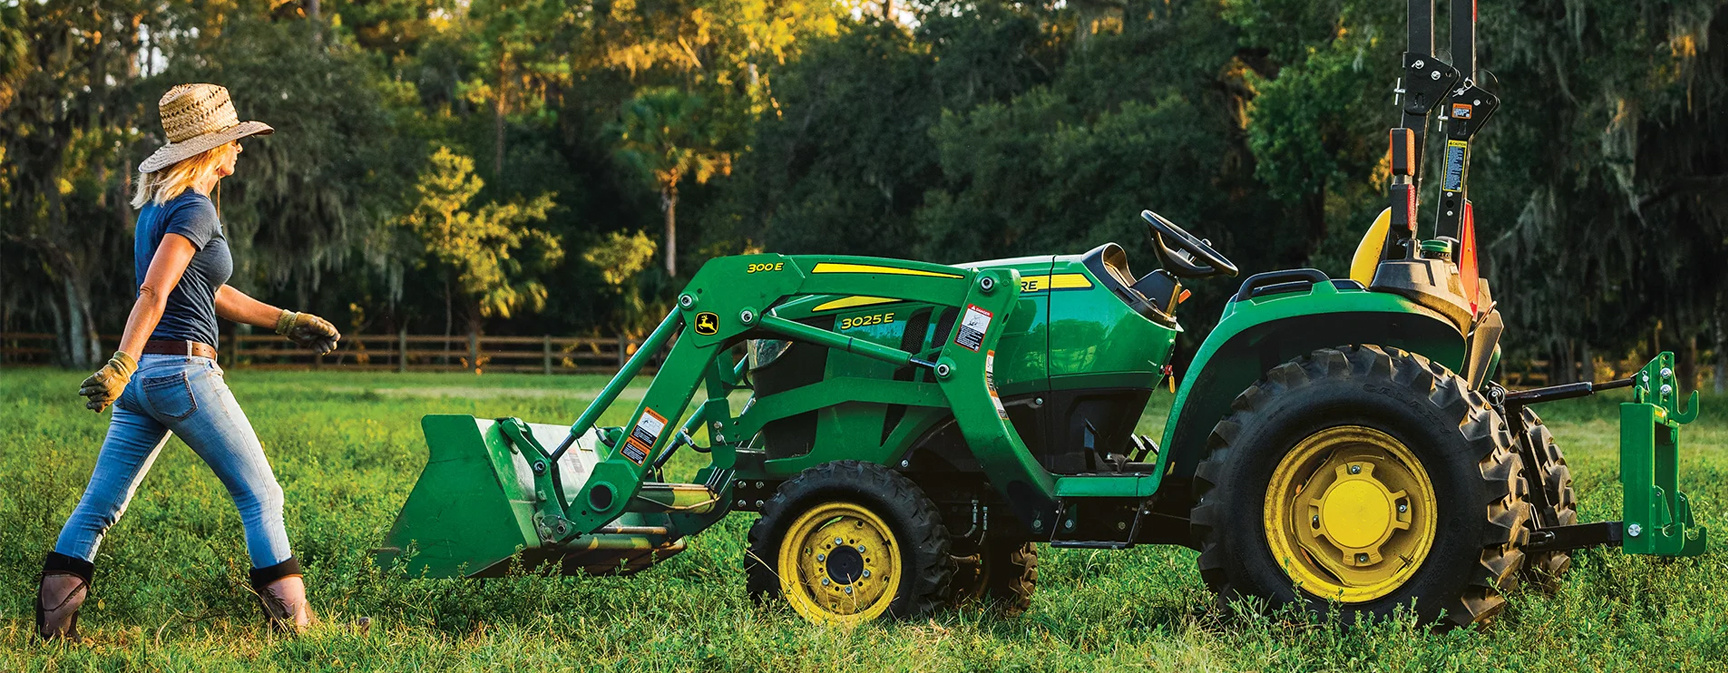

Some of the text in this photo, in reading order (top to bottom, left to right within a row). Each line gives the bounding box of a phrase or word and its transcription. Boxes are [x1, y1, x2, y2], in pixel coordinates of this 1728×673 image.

[747, 262, 784, 274] 300 E
[841, 312, 895, 330] 3025 E
